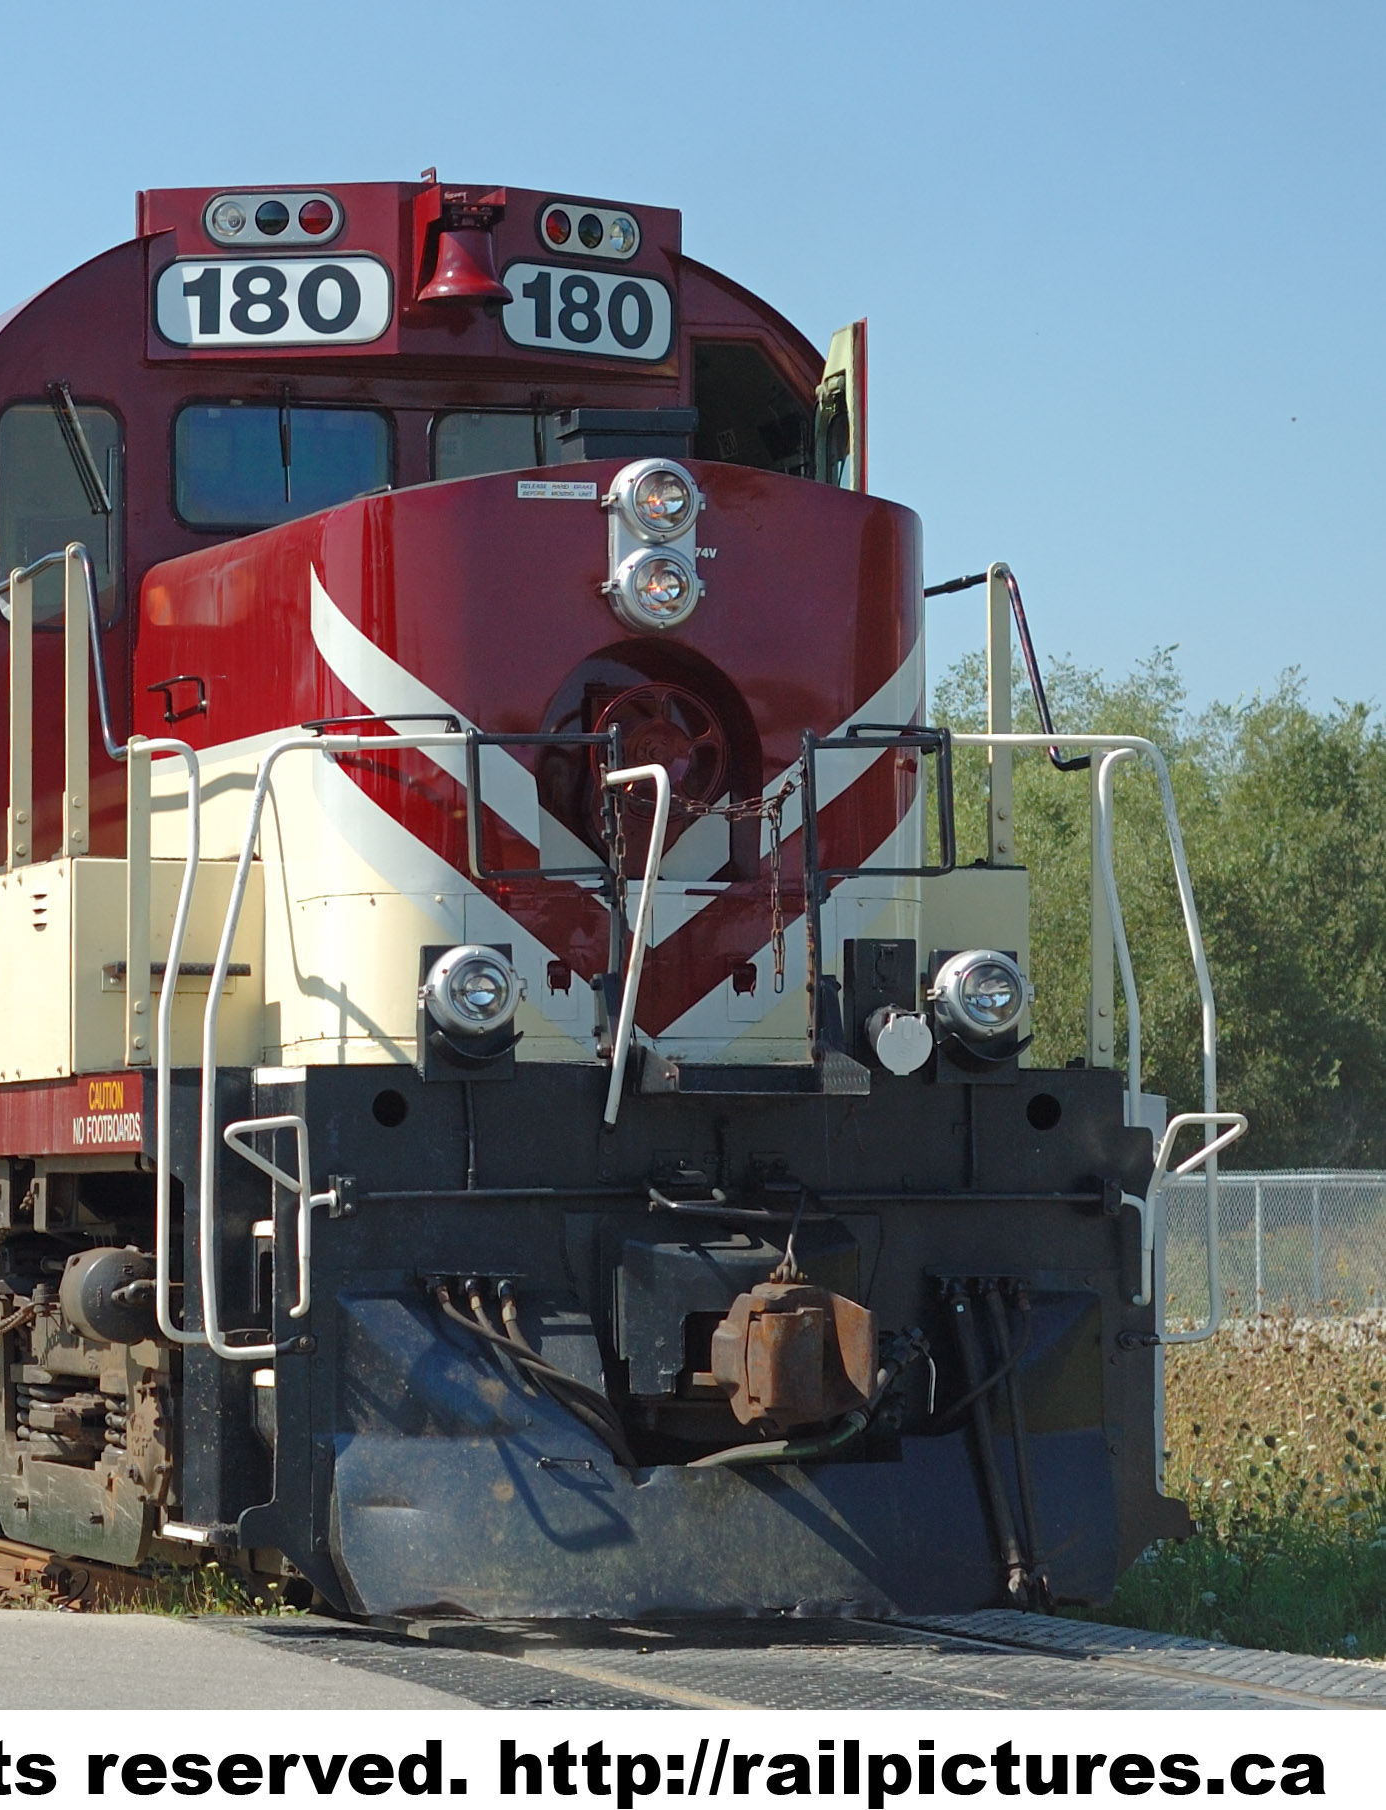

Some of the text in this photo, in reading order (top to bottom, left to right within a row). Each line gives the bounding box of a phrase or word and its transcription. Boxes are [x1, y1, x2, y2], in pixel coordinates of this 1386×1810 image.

[183, 265, 361, 335] 180
[523, 271, 653, 350] 180
[88, 1081, 124, 1111] CAUTION
[73, 1111, 142, 1145] NO FOOTBOARDS
